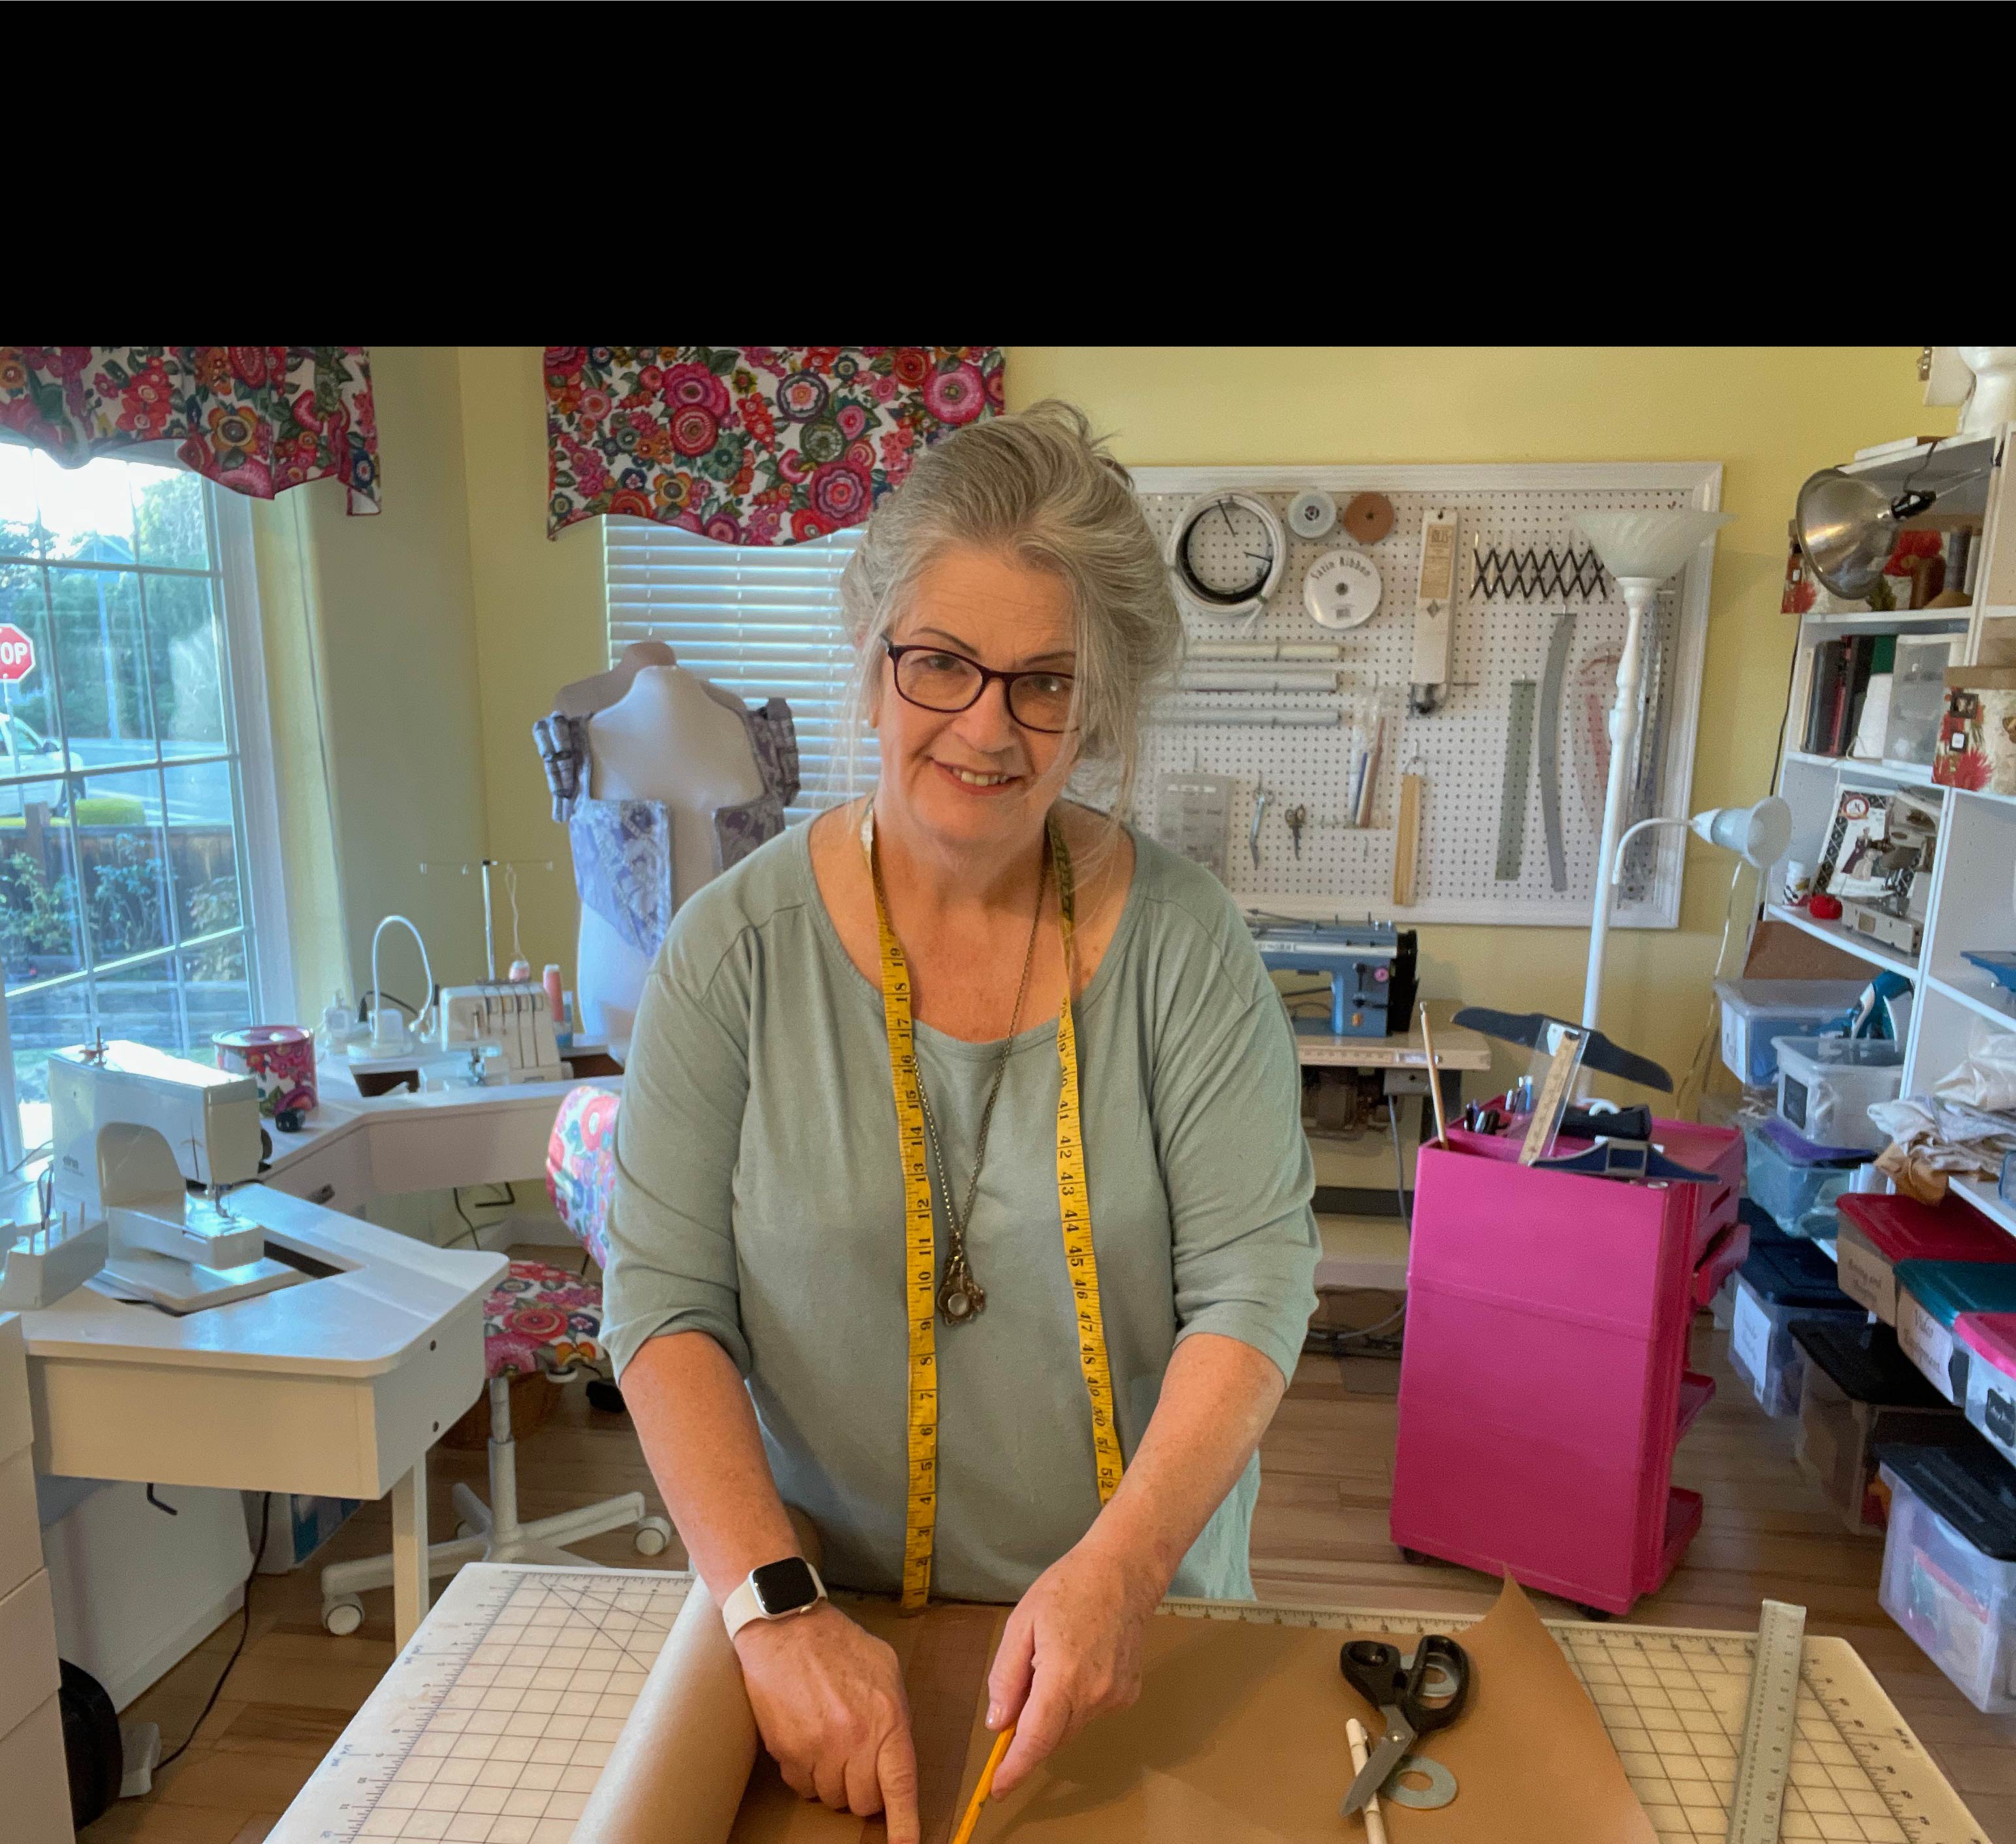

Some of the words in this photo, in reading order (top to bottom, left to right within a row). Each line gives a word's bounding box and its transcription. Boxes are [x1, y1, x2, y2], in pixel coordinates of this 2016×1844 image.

[1310, 561, 1335, 580] Satin
[0, 642, 27, 665] OP
[921, 1460, 933, 1471] 5
